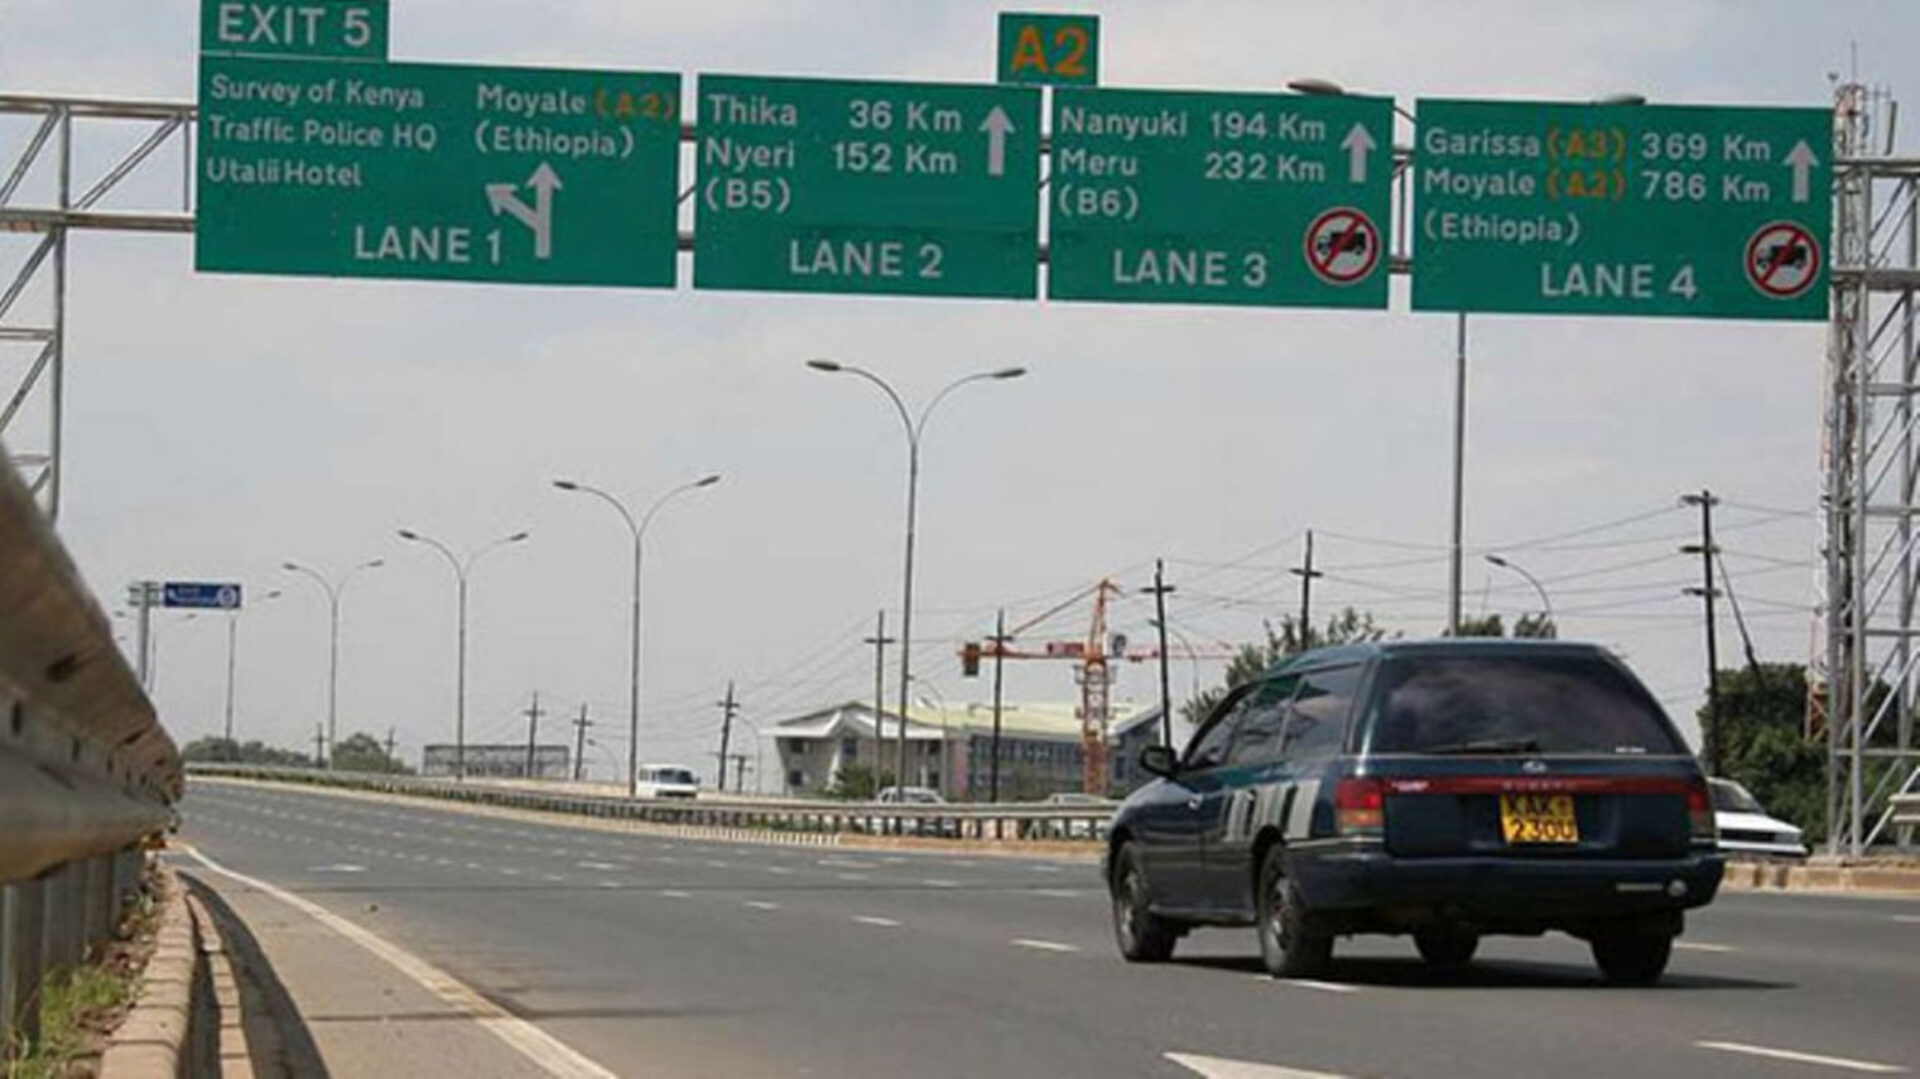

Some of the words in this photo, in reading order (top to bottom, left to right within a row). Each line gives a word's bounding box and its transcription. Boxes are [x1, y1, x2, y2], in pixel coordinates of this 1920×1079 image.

[217, 3, 325, 45] EXIT
[345, 9, 371, 47] 5
[1012, 25, 1088, 75] A2
[211, 74, 298, 106] Survey
[308, 78, 336, 102] of
[347, 80, 424, 112] Kenya
[478, 83, 585, 118] Moyale
[708, 94, 797, 125] Thika
[850, 100, 892, 129] 36
[907, 102, 961, 131] Km
[1061, 108, 1187, 140] Nanyuki
[1211, 112, 1266, 138] 194
[1279, 114, 1325, 140] Km
[209, 116, 294, 144] Traffic
[304, 121, 383, 147] Police
[393, 123, 437, 150] HQ
[475, 122, 634, 158] (Ethiopia)
[1425, 128, 1540, 157] Garissa
[1642, 133, 1707, 159] 369
[1723, 135, 1770, 161] Km
[706, 137, 794, 172] Nyeri
[834, 143, 891, 172] 152
[906, 145, 957, 173] Km
[1060, 150, 1137, 176] Meru
[1205, 152, 1266, 180] 232
[1278, 156, 1324, 181] Km
[705, 178, 791, 213] (B5)
[1059, 184, 1139, 220] (B6)
[1424, 168, 1535, 198] Moyale
[1643, 171, 1705, 199] 786
[1723, 176, 1769, 201] Km
[355, 225, 470, 262] LANE
[487, 230, 500, 263] 1
[1425, 209, 1579, 245] (Ethiopia)
[790, 240, 902, 276] LANE
[920, 244, 943, 278] 2
[1113, 251, 1226, 286] LANE
[1244, 254, 1267, 287] 3
[1542, 263, 1653, 297] LANE
[1670, 265, 1697, 299] 4
